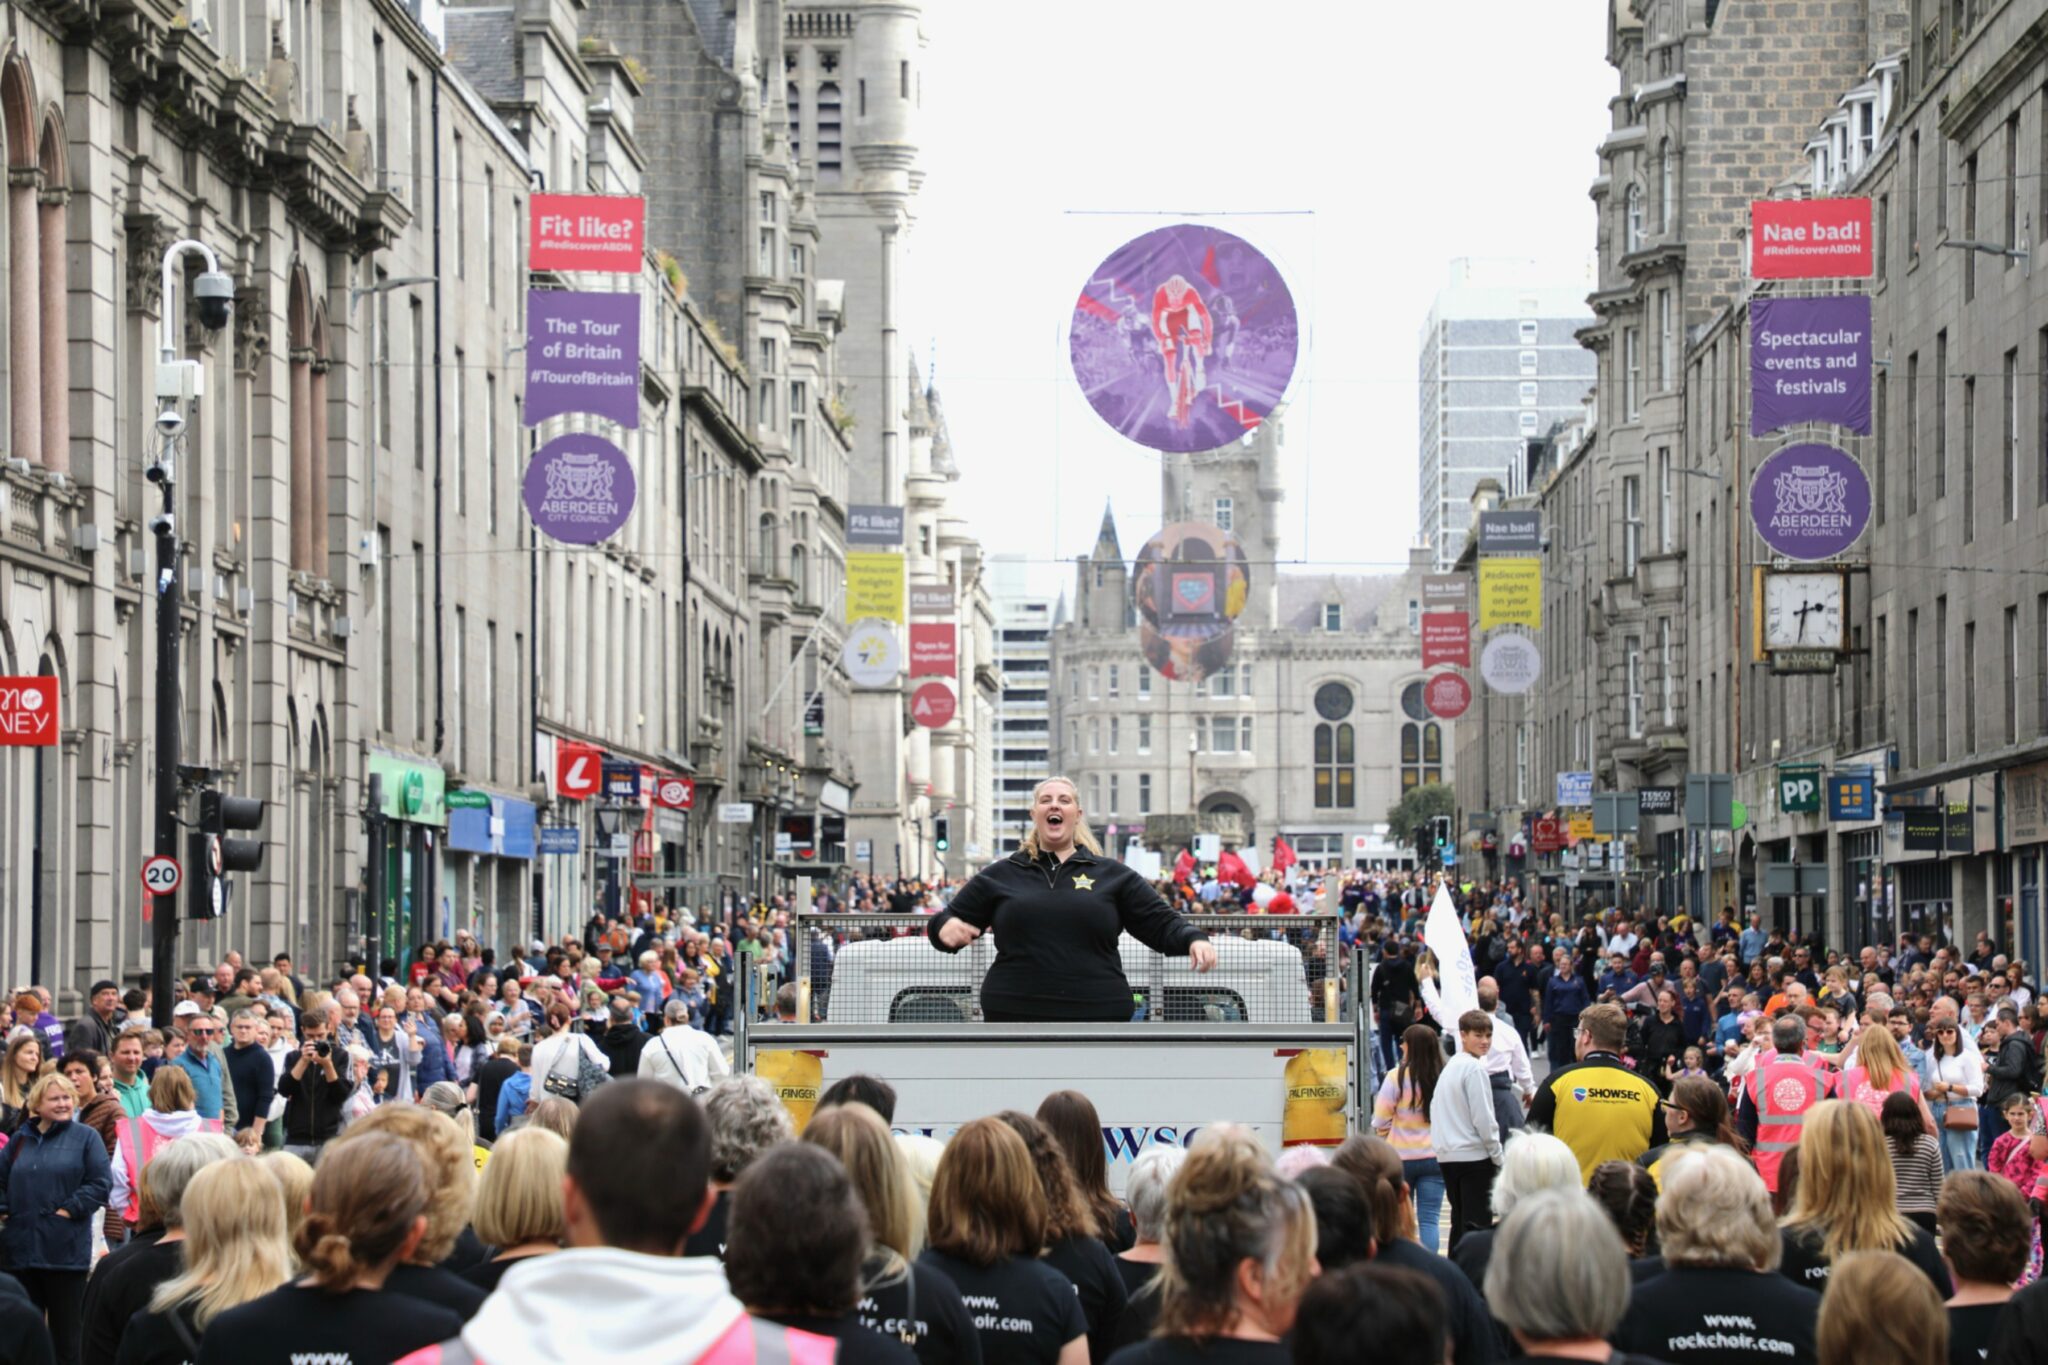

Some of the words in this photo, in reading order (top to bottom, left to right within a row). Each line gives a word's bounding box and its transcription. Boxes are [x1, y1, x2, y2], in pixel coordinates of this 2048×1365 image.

[540, 215, 573, 237] Fit
[579, 216, 634, 239] like?
[1763, 223, 1806, 241] Nae
[1812, 221, 1861, 240] bad!
[1763, 244, 1861, 256] #RediscoverABDN
[545, 318, 577, 334] The
[581, 319, 622, 336] Tour
[1760, 328, 1861, 350] Spectacular
[542, 341, 562, 358] of
[565, 343, 622, 360] Britain
[1764, 356, 1821, 370] events
[1825, 351, 1857, 368] and
[530, 369, 634, 386] #TourofBritain
[1775, 377, 1847, 395] festivals
[540, 501, 619, 515] ABERDEEN
[548, 514, 568, 522] CITY
[570, 514, 610, 524] COUNCIL
[851, 515, 868, 527] Fit
[870, 516, 899, 529] like?
[1769, 515, 1852, 528] ABERDEEN
[1485, 524, 1508, 533] Nae
[1510, 522, 1535, 533] bad!
[1778, 528, 1799, 537] CITY
[1801, 528, 1843, 537] COUNCIL
[148, 867, 176, 884] 20
[1288, 1087, 1340, 1099] PALFINGER
[1588, 1087, 1641, 1102] SHOWSEC
[1703, 1314, 1756, 1330] www.
[1668, 1331, 1795, 1356] rockchoir.com
